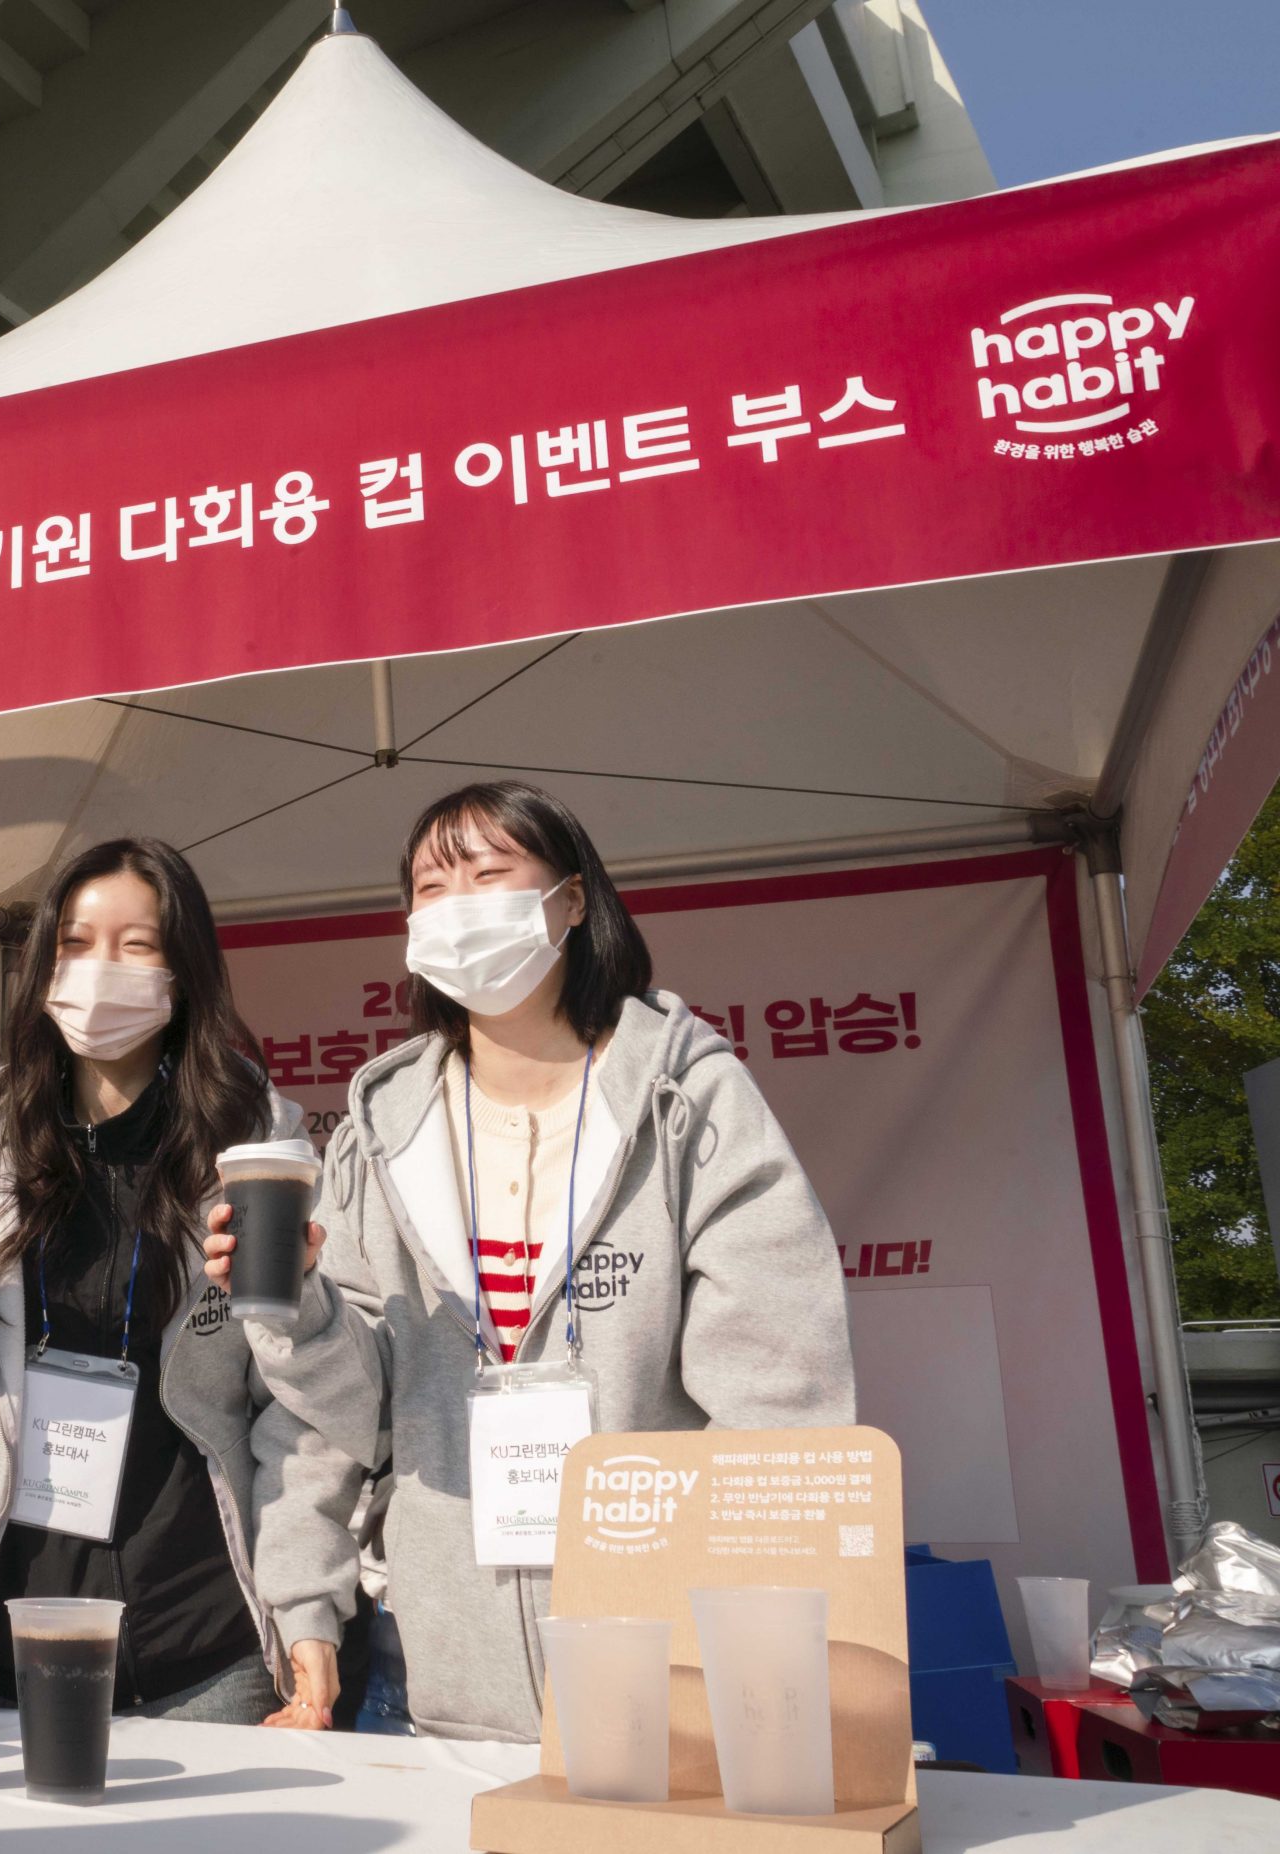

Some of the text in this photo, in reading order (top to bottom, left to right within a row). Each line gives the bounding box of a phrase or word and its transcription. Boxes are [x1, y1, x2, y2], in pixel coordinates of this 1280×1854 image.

[970, 296, 1195, 368] happy
[978, 346, 1165, 419] habit
[993, 418, 1159, 460] 환경을 위한 행복한 습관
[120, 471, 330, 563] 다회용
[359, 452, 425, 530] 컵
[454, 406, 700, 505] 이벤트
[727, 376, 907, 463] 부스
[764, 992, 921, 1059] 압승!
[573, 1252, 644, 1274] appy
[32, 1417, 107, 1442] KU그린캠퍼스
[42, 1441, 89, 1462] 홍보대사
[490, 1442, 571, 1459] KU그린캠퍼스
[763, 1452, 800, 1464] 다회용
[803, 1451, 816, 1464] 컵
[819, 1450, 843, 1463] 사용
[846, 1449, 872, 1463] 방법
[507, 1467, 559, 1485] 홍보대사
[585, 1465, 699, 1495] happy
[722, 1475, 754, 1487] 다회용
[769, 1475, 801, 1487] 보증금
[805, 1474, 847, 1486] 1,000원
[723, 1492, 745, 1504] 무인
[748, 1492, 793, 1504] 반납기에
[796, 1491, 830, 1503] 다회용
[848, 1490, 872, 1503] 반납
[583, 1496, 677, 1523] habit
[769, 1509, 801, 1521] 보증금
